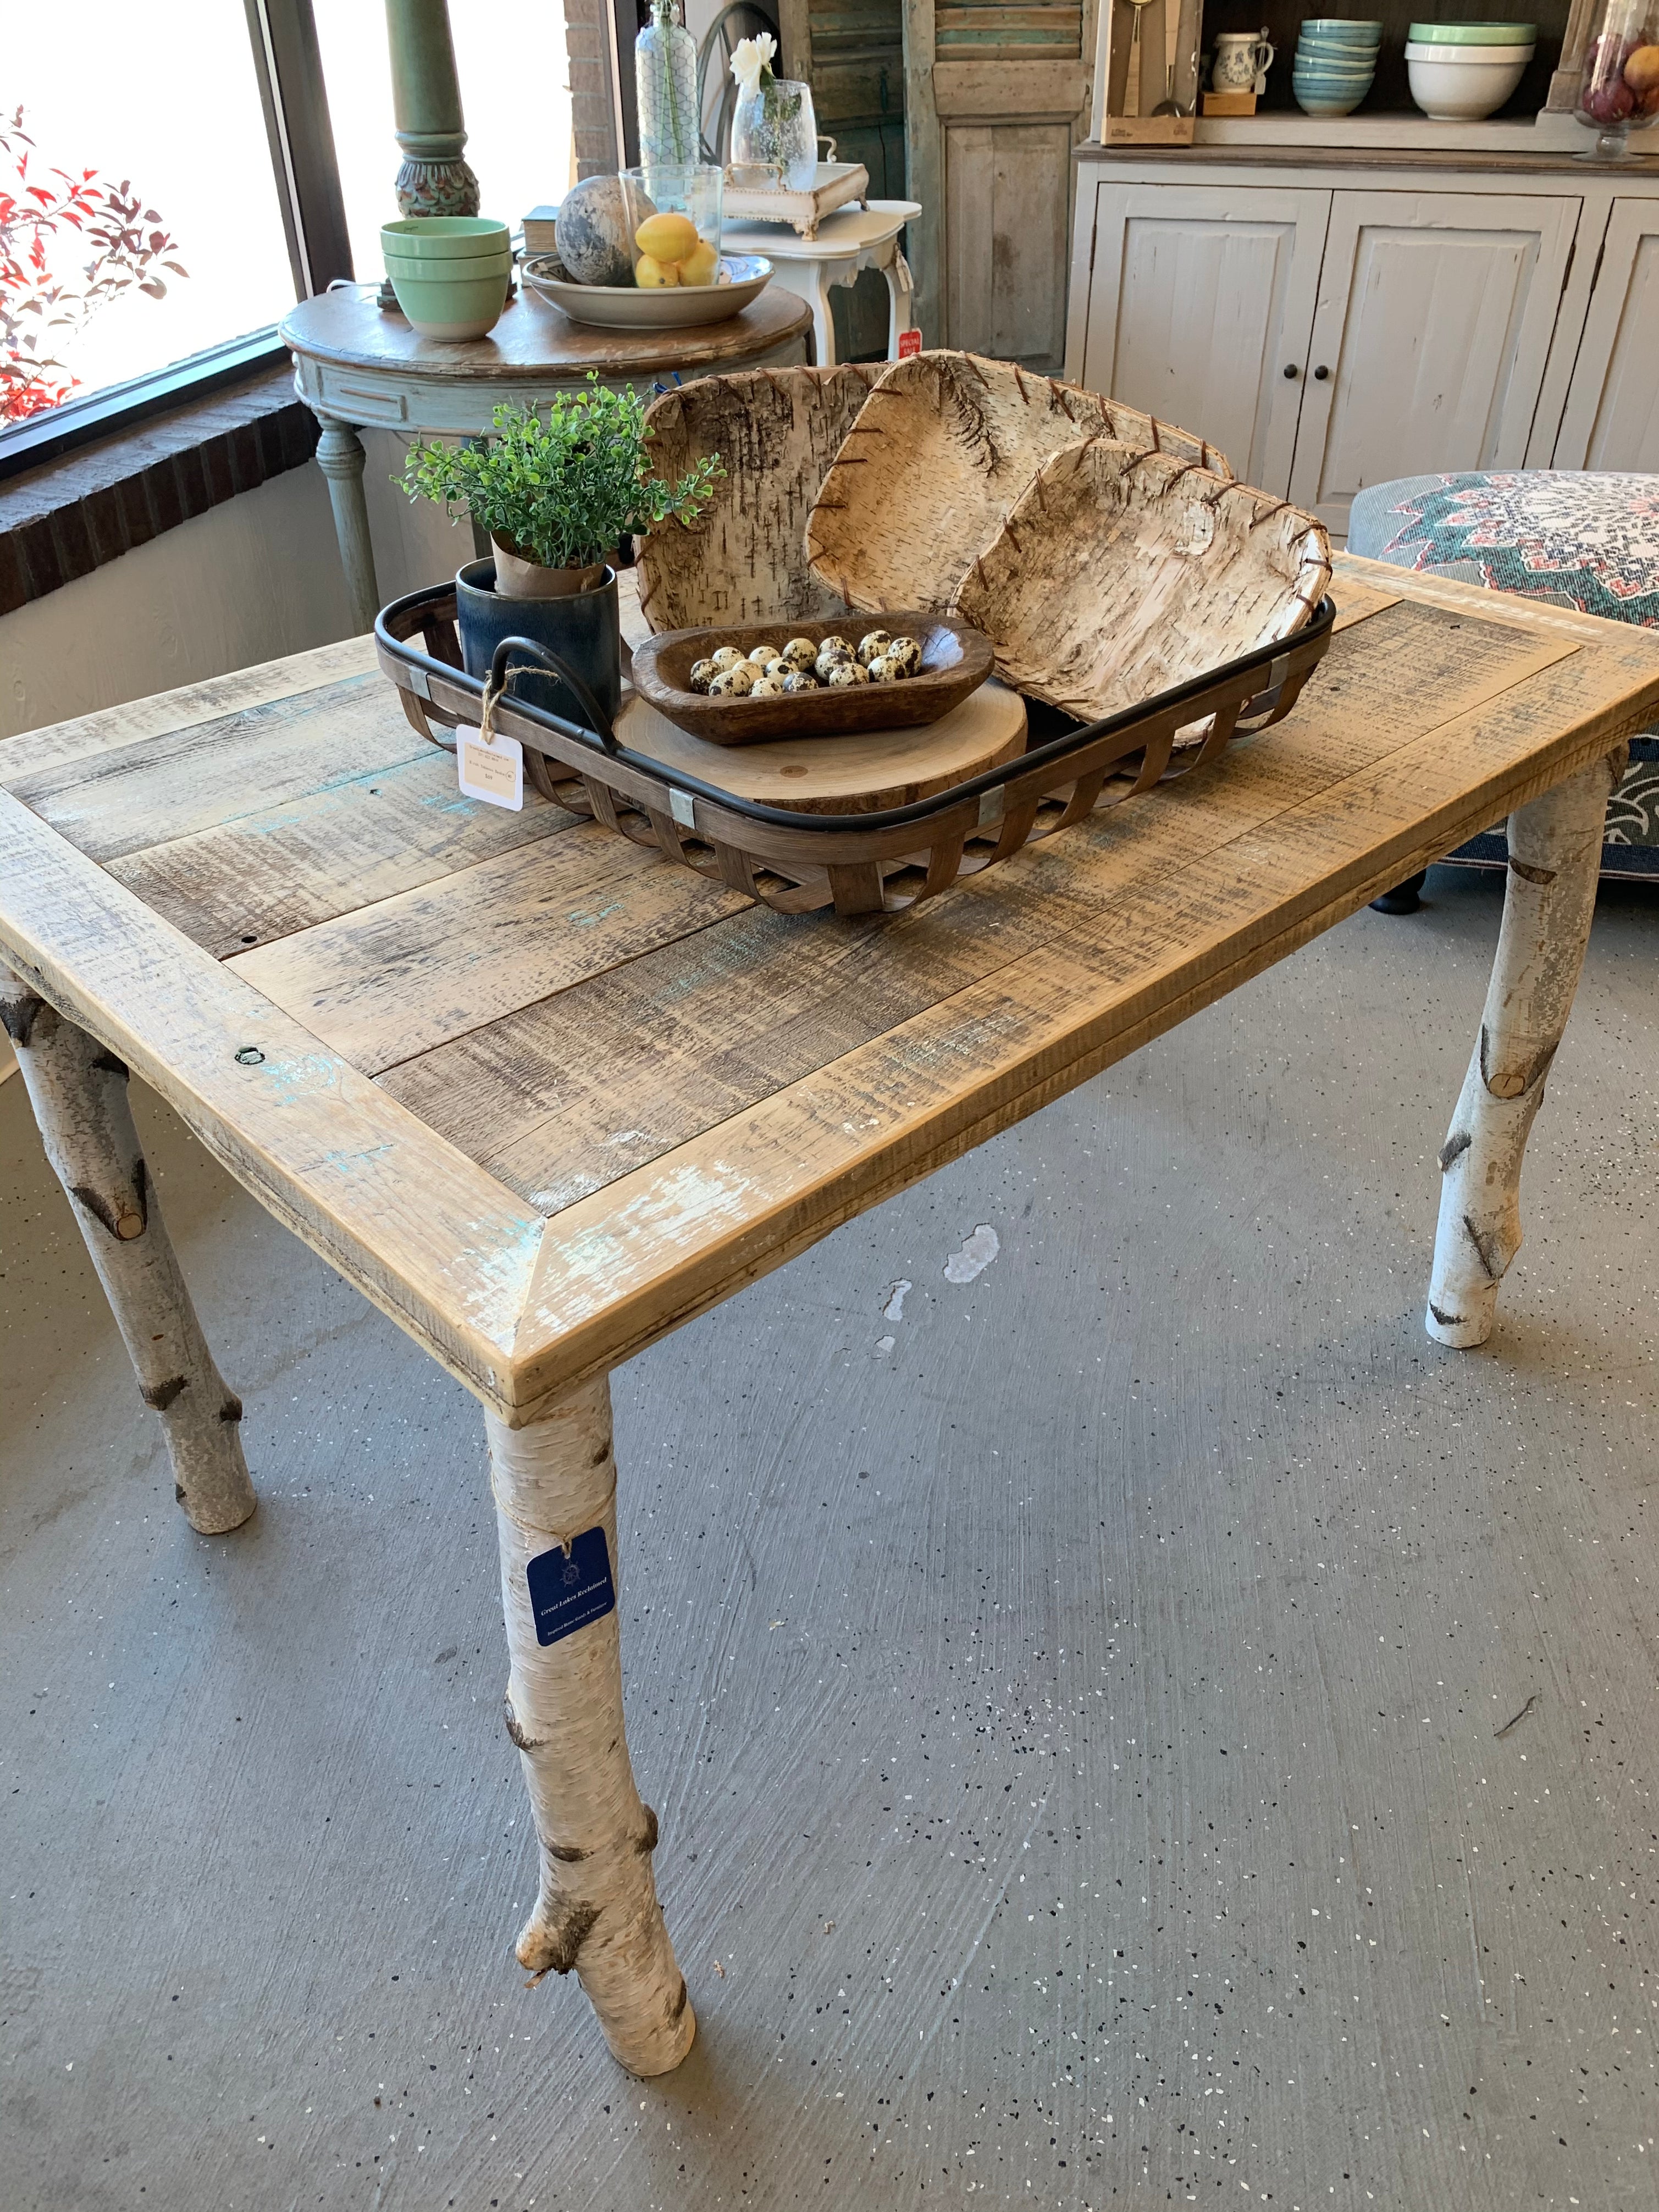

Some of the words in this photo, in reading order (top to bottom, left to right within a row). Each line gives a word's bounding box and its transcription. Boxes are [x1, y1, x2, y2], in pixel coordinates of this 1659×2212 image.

[900, 338, 920, 347] SPECIAL
[904, 346, 915, 356] SALE
[541, 1603, 558, 1616] Great
[560, 1594, 577, 1606] Lakes
[578, 1577, 607, 1597] Reclaimed
[548, 1624, 563, 1636] Inspired
[575, 1613, 587, 1621] Goods
[590, 1602, 607, 1613] Furniture
